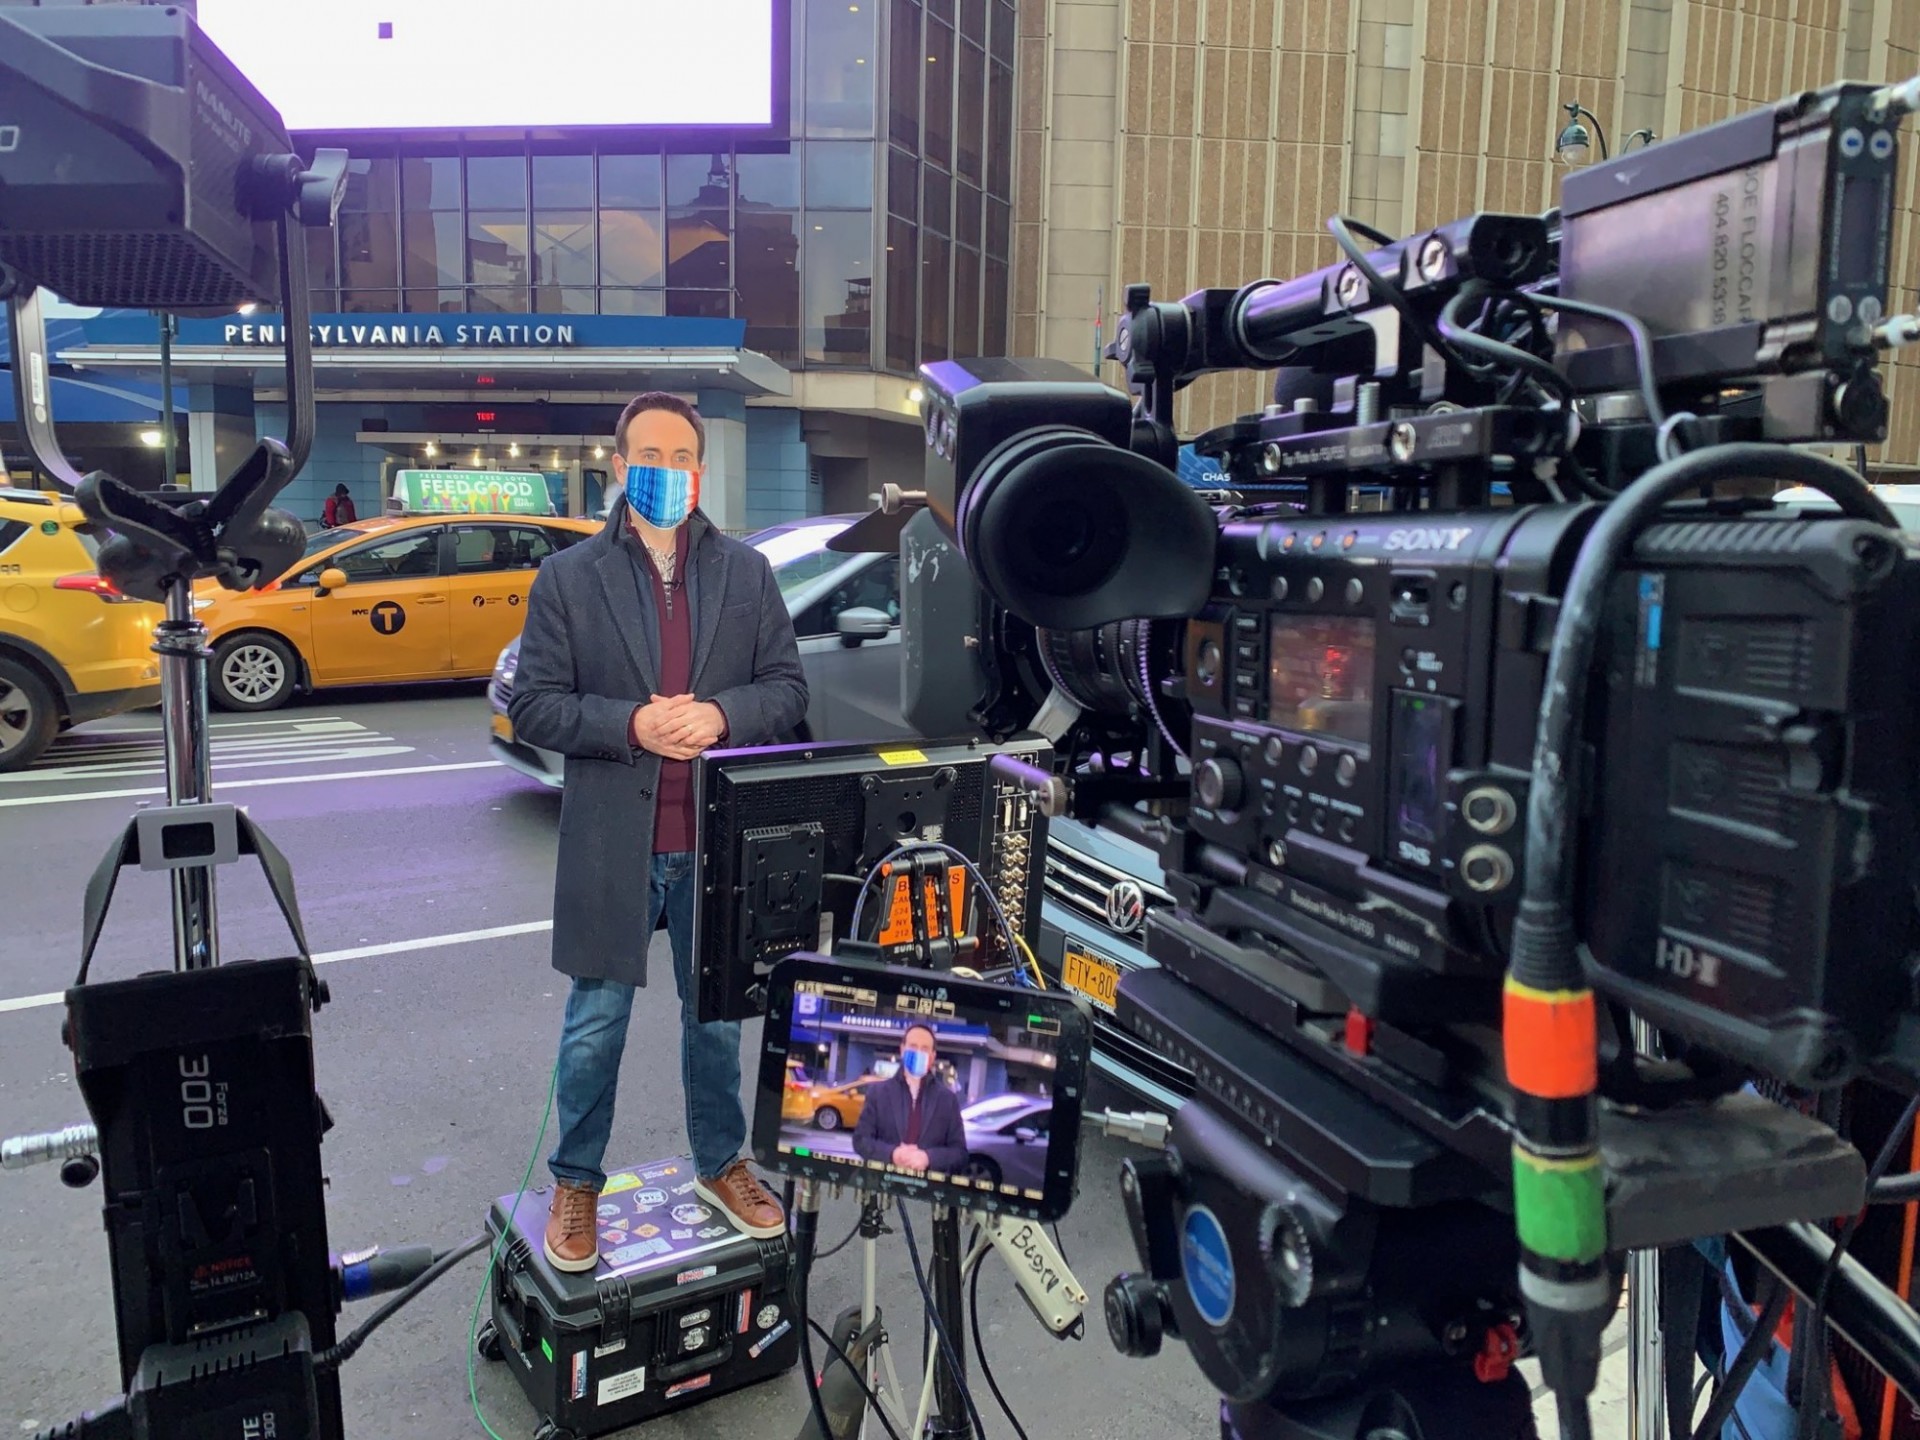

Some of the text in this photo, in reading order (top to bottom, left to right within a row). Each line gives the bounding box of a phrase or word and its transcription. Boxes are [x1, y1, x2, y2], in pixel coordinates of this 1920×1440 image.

[224, 324, 573, 344] PENYLVANIA STATION
[420, 479, 469, 495] FEED
[1202, 472, 1231, 482] CHAS
[1383, 527, 1472, 550] SONY
[179, 1054, 213, 1128] 300
[215, 1082, 228, 1125] Forza
